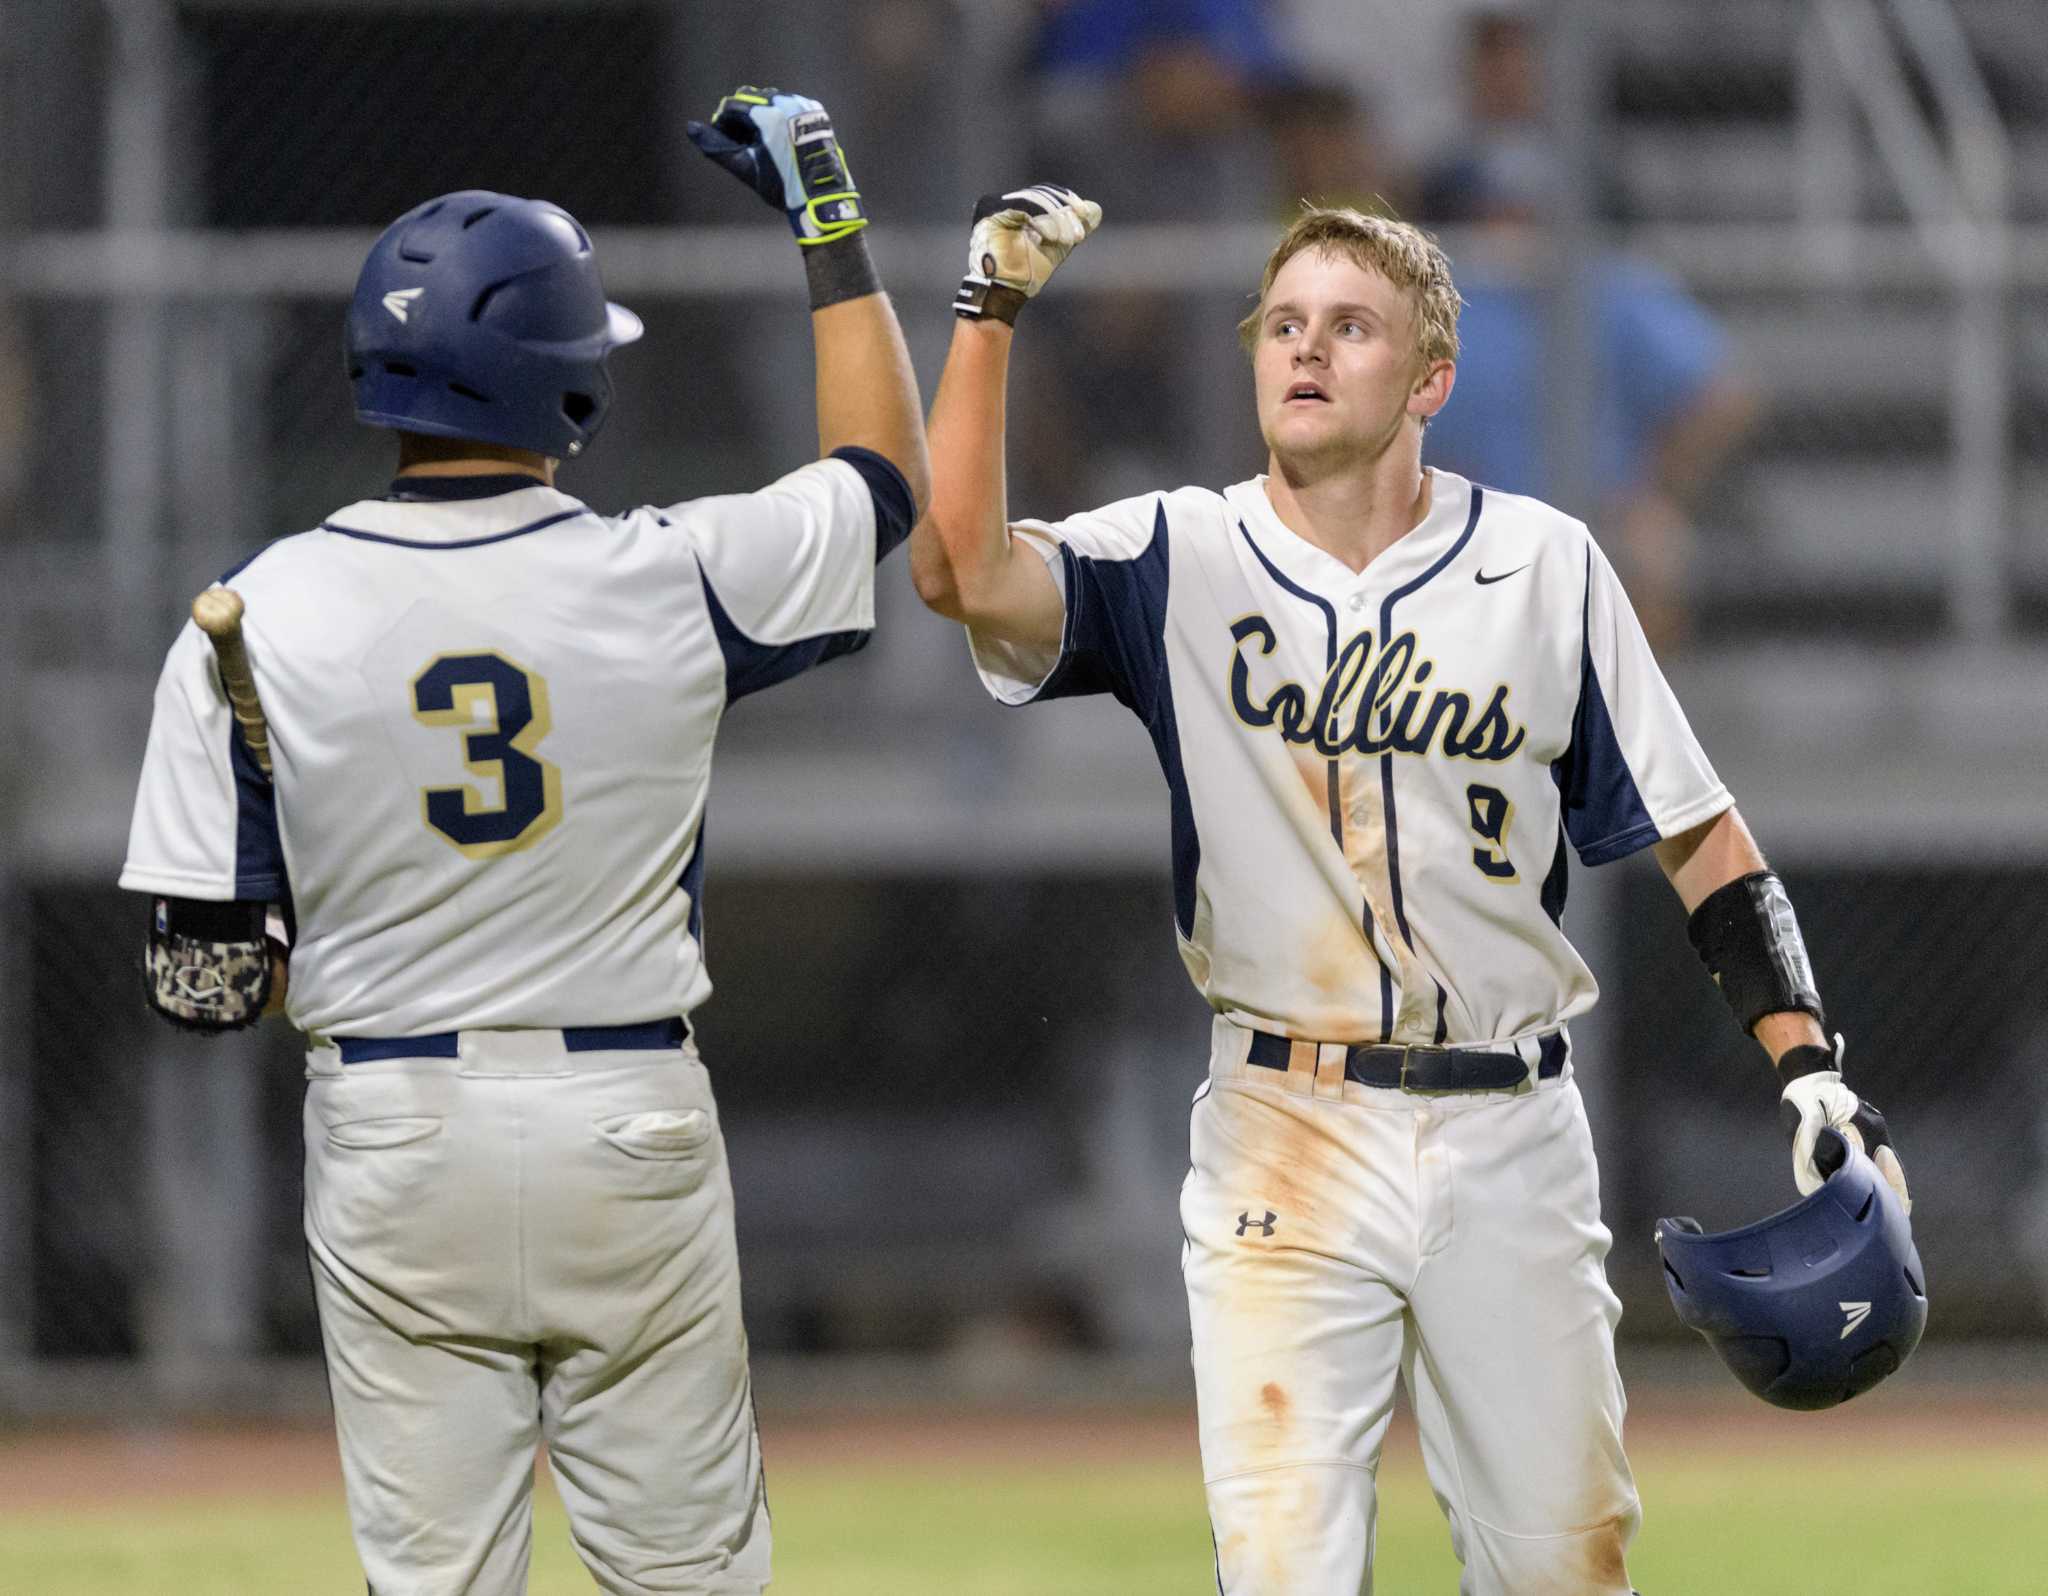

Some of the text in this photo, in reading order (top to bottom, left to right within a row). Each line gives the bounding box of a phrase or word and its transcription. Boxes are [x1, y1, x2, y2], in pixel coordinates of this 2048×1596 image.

[408, 649, 563, 860] 3
[1228, 612, 1528, 764] Collins
[1466, 783, 1520, 884] 9
